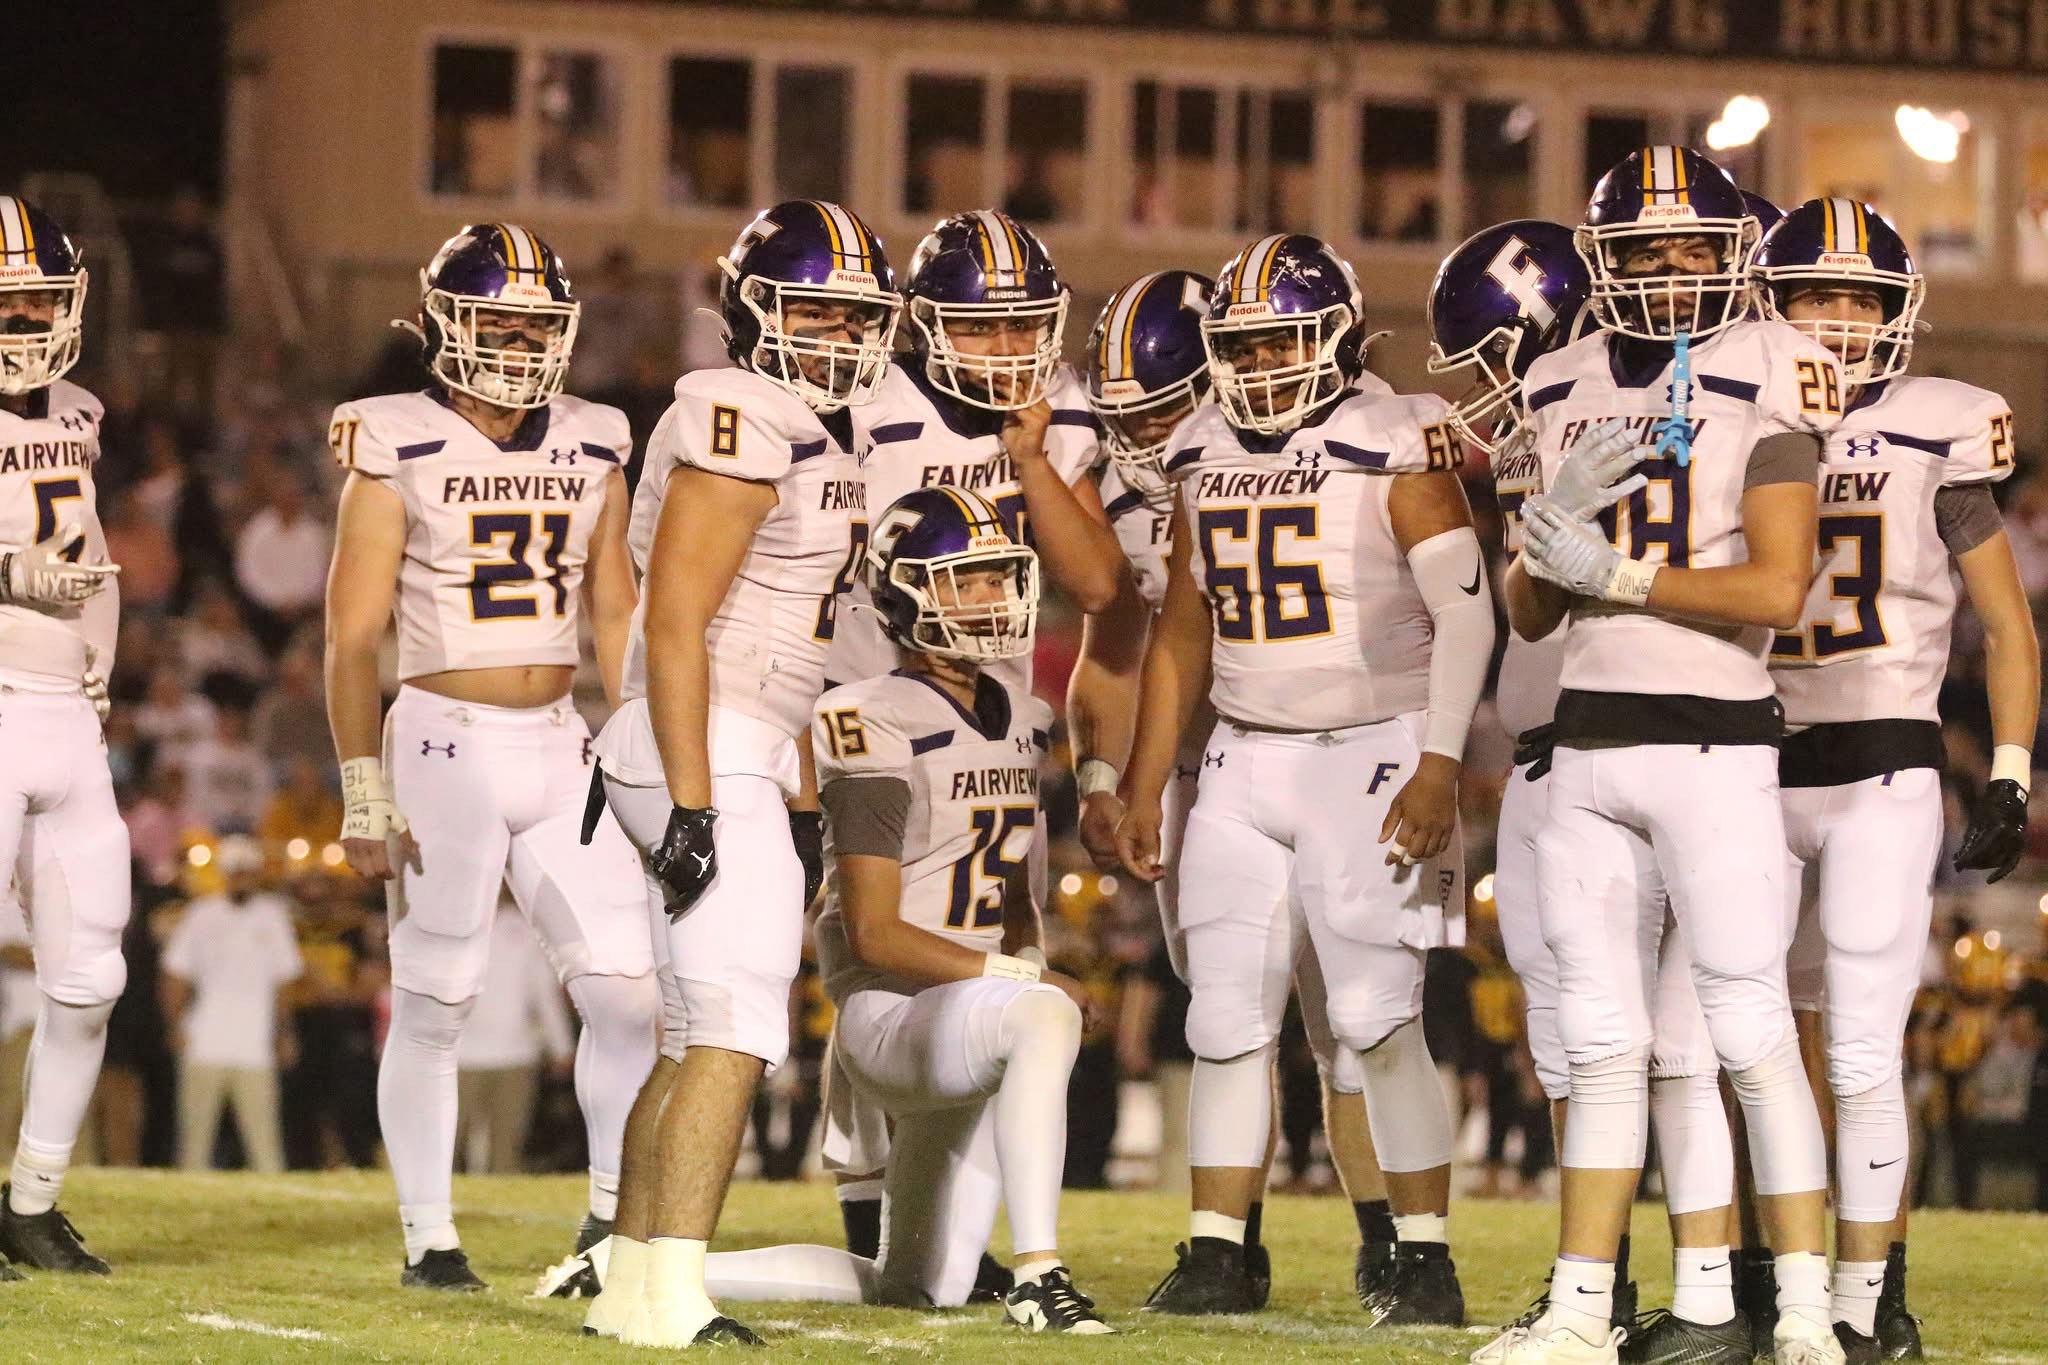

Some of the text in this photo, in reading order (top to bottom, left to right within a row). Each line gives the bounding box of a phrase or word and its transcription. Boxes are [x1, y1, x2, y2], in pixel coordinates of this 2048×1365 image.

[1229, 305, 1267, 316] Riddell
[1794, 357, 1842, 416] 28
[330, 419, 361, 466] 21
[710, 402, 741, 459] 8
[443, 476, 586, 504] FAIRVIEW
[1196, 470, 1331, 498] FAIRVIEW
[468, 510, 572, 624] 21
[1197, 502, 1336, 644] 66
[819, 707, 870, 760] 15
[951, 767, 1039, 800] FAIRVIEW
[1366, 763, 1400, 795] F
[943, 803, 1037, 931] 15
